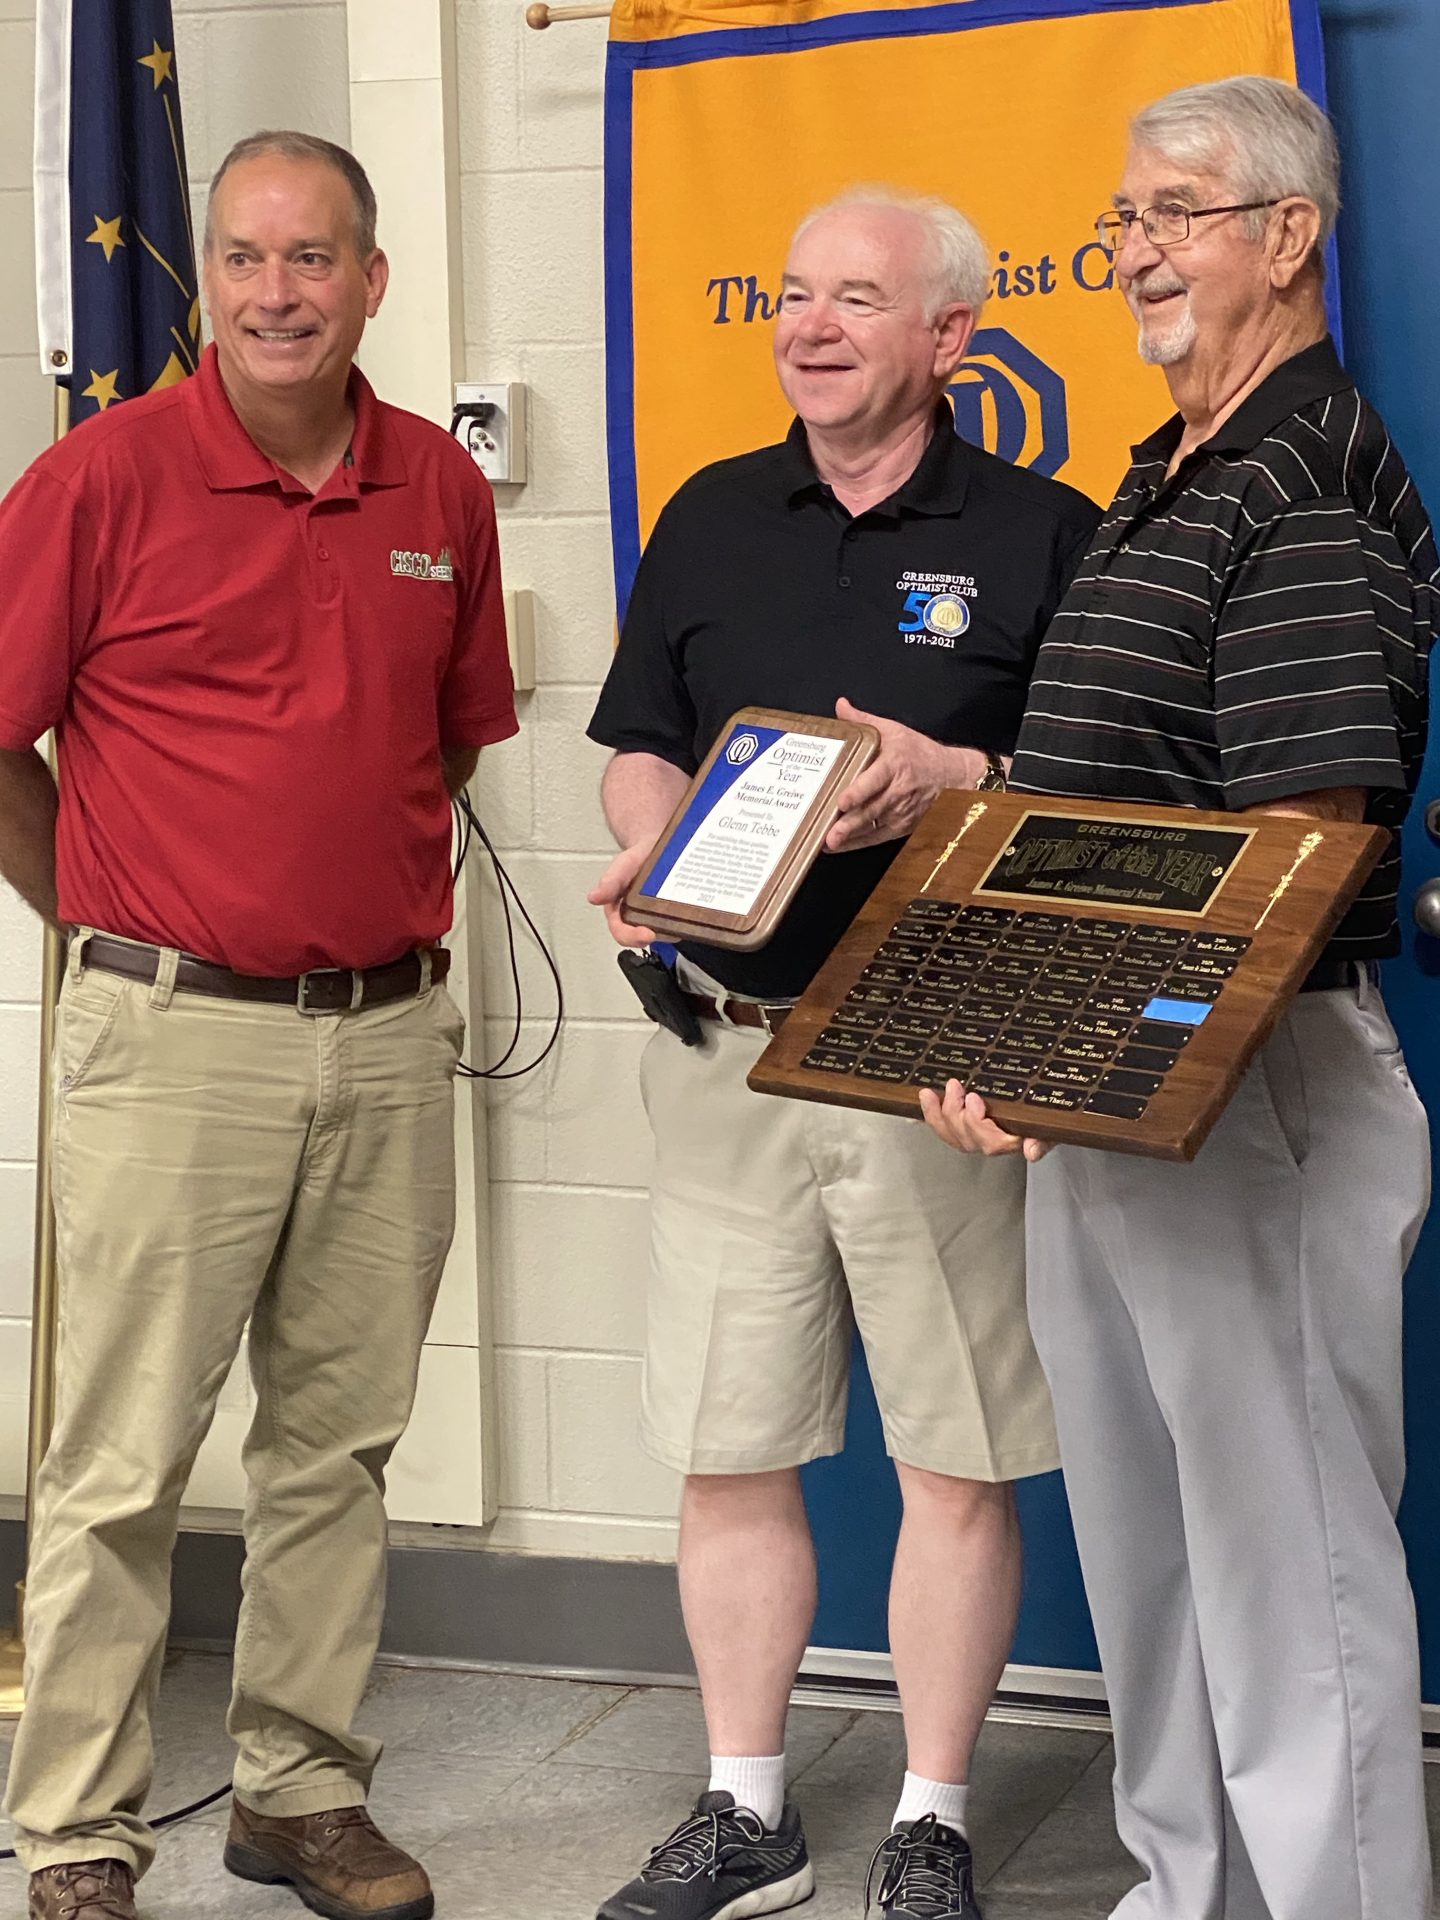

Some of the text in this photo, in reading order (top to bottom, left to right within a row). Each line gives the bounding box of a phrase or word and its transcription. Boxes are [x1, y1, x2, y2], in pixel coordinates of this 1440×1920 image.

[390, 550, 432, 577] CISCO
[902, 571, 975, 586] GREENSBURG
[896, 581, 978, 597] OPTIMIST CLUB
[904, 633, 955, 649] 1971-2021
[786, 738, 827, 753] Greensburg
[773, 747, 827, 766] Optimist
[778, 768, 802, 783] Year
[741, 781, 765, 793] James
[777, 787, 804, 799] Greiwe
[735, 792, 800, 810] Memorial Award
[718, 816, 780, 837] Glenn Tebbe
[1077, 824, 1188, 842] GREENSBURG
[1005, 838, 1111, 877] OPTIMIST
[1154, 848, 1217, 896] YEAR
